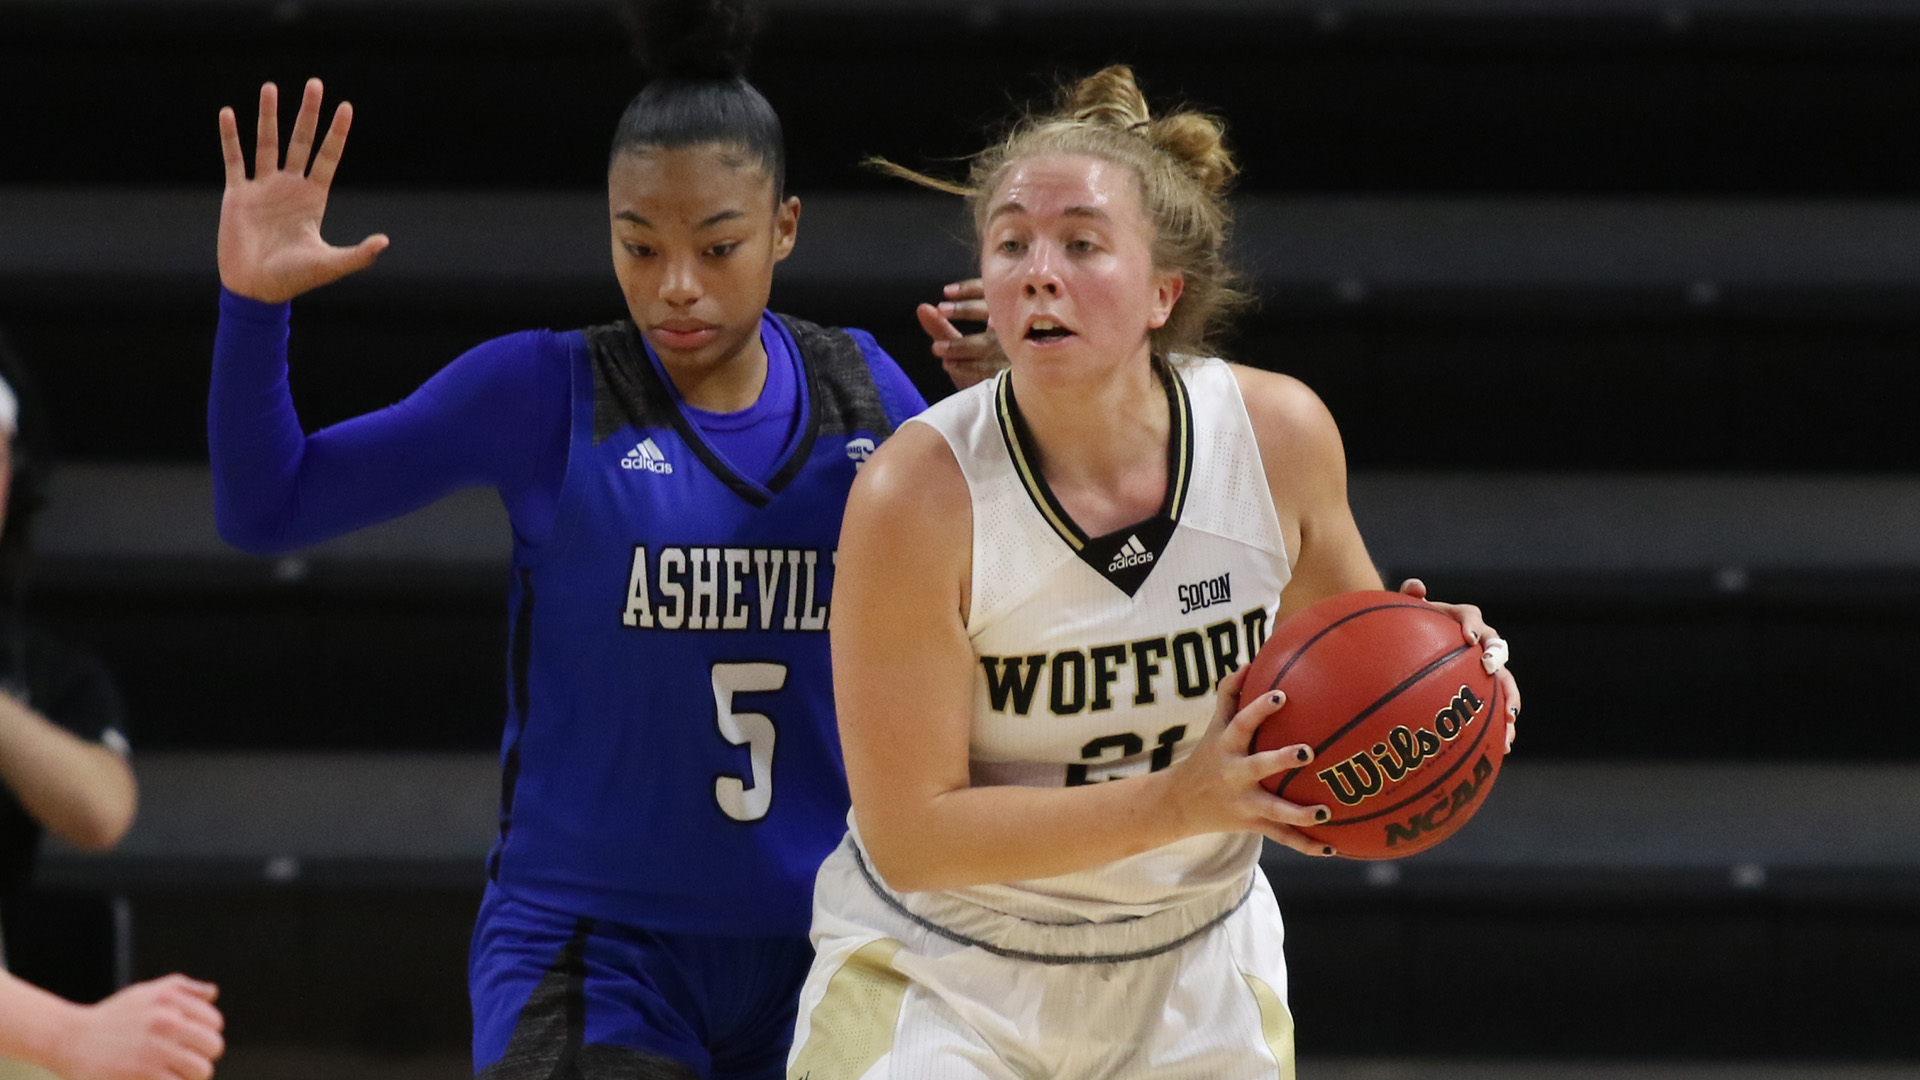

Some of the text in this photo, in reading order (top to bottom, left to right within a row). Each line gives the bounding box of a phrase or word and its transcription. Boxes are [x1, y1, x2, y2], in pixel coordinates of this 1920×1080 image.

[621, 455, 673, 475] adidas
[622, 546, 836, 631] ASHEVIL
[1108, 551, 1154, 572] adidas
[710, 662, 788, 822] 5
[1316, 684, 1485, 806] Wilson
[1385, 753, 1494, 847] NCAA
